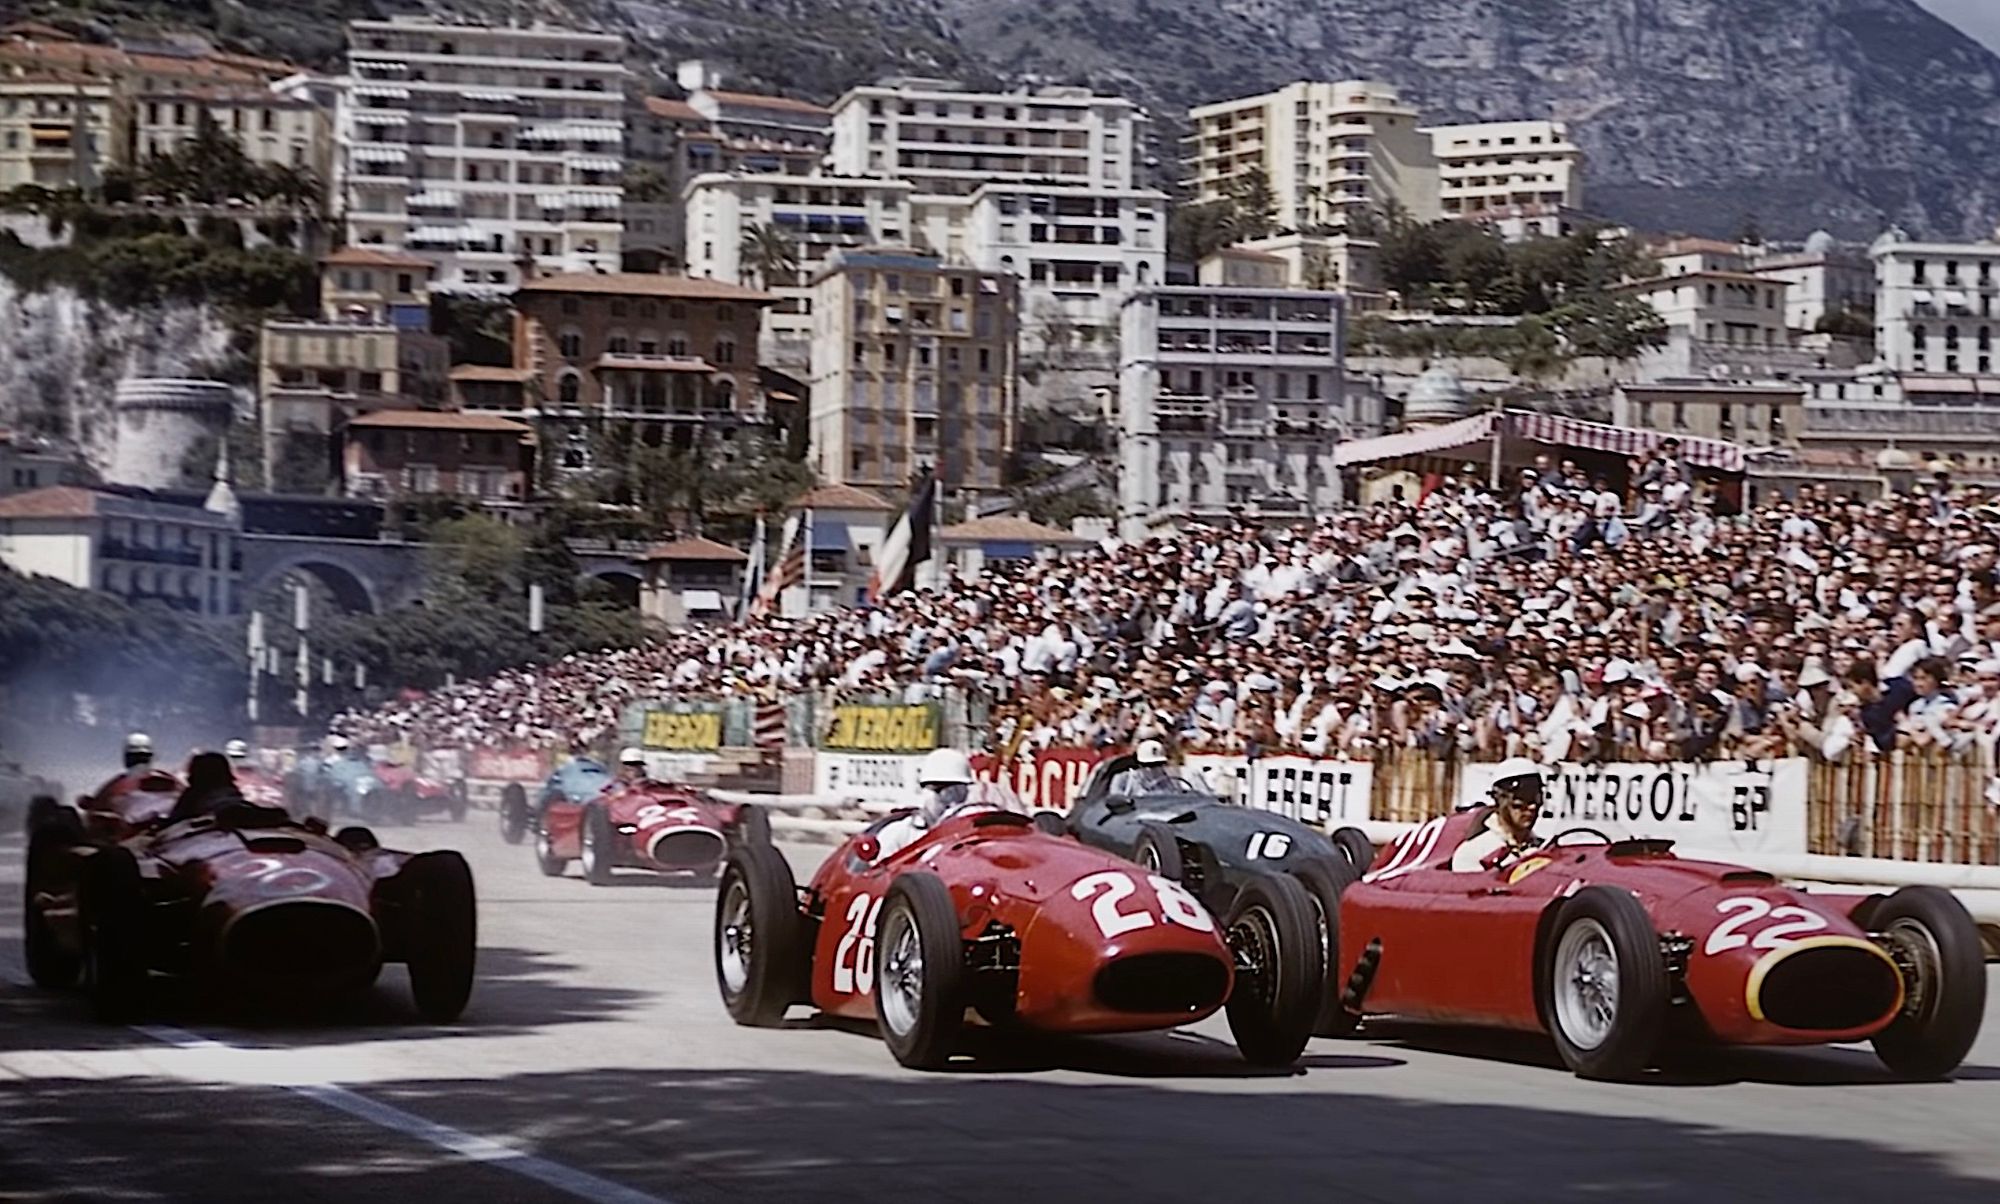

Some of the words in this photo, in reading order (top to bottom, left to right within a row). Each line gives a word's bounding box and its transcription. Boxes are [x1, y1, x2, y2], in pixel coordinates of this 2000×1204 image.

[1541, 771, 1698, 822] ENERGOL
[1732, 785, 1771, 831] BP
[1244, 830, 1292, 862] 16
[1361, 814, 1447, 884] 22
[1070, 869, 1215, 940] 28
[1704, 896, 1829, 956] 22
